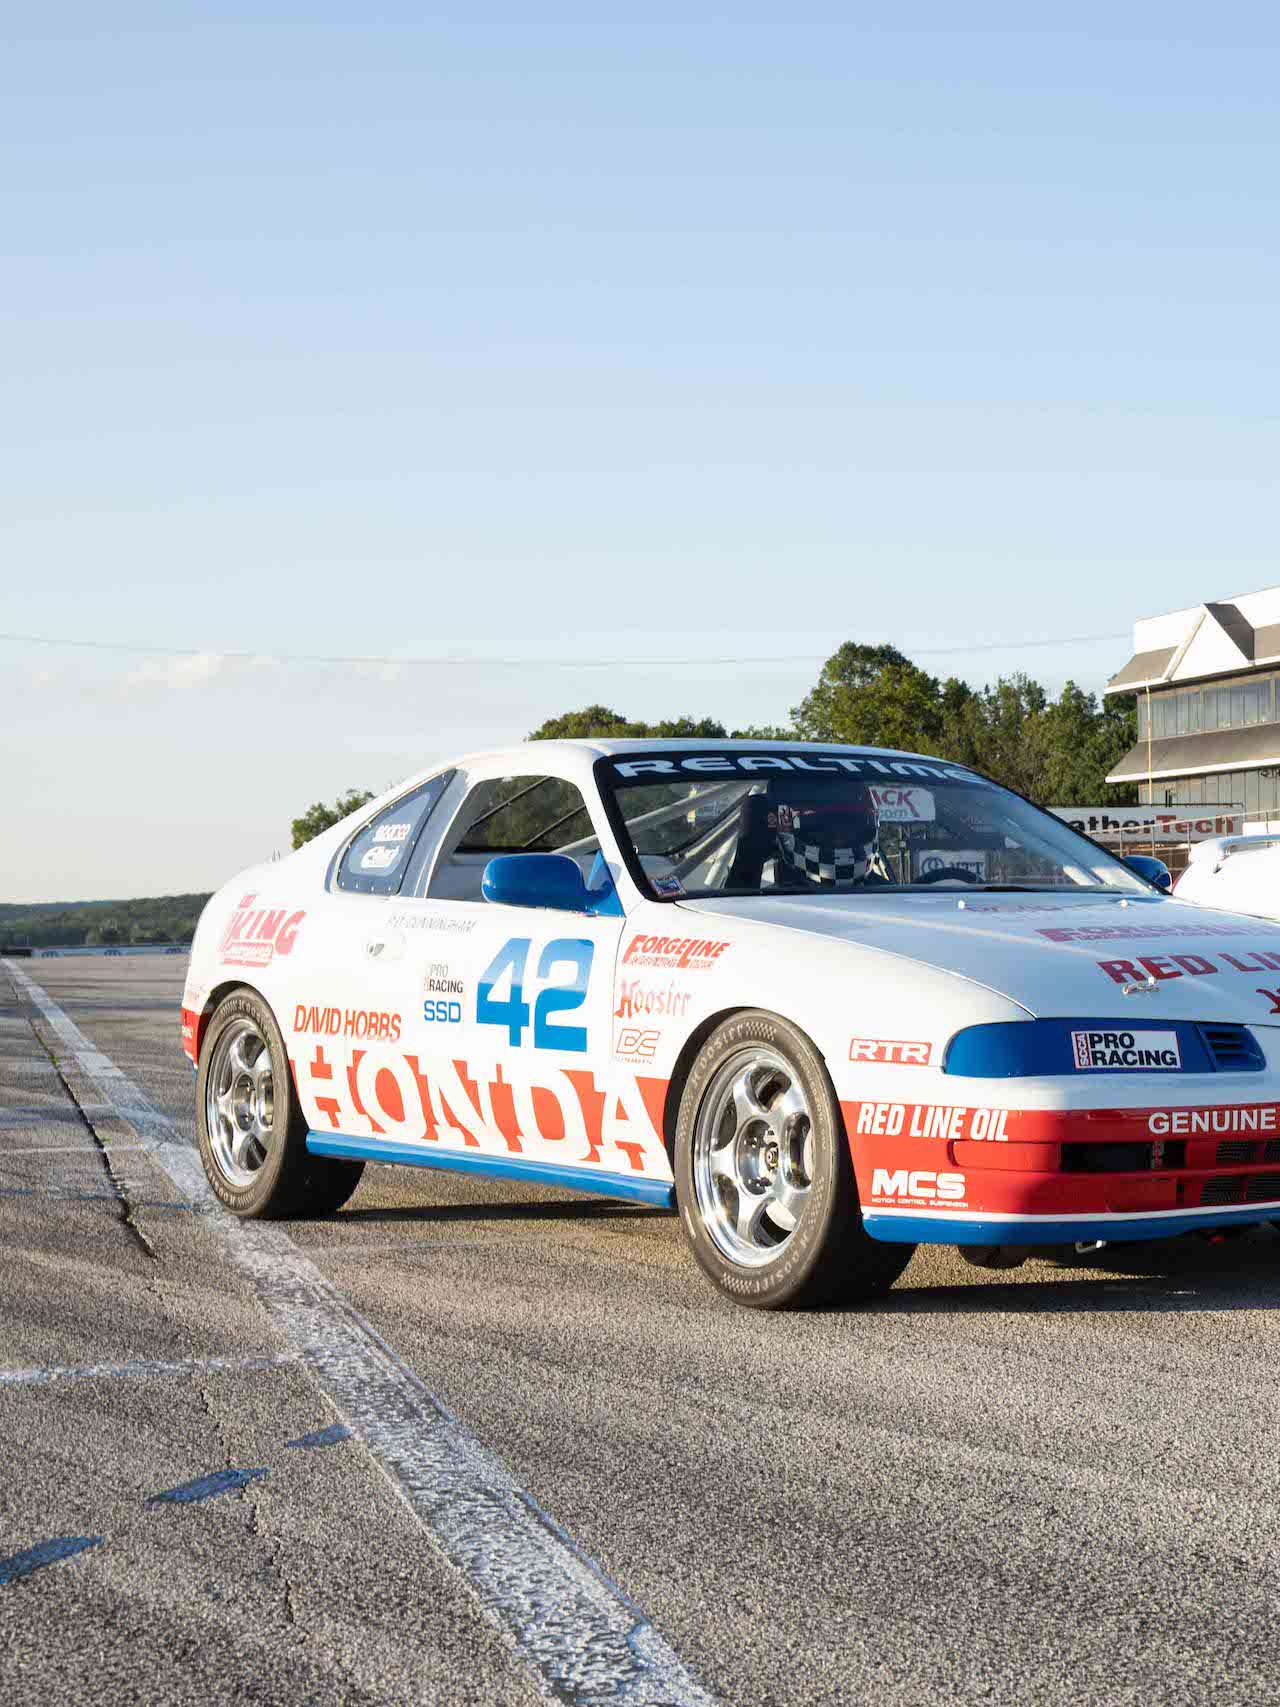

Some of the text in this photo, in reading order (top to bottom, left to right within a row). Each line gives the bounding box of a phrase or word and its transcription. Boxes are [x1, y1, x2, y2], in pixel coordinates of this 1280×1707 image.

[1069, 815, 1233, 834] atherTech
[622, 935, 730, 968] FORGELINE
[430, 963, 448, 977] PRO
[1097, 955, 1218, 983] RED
[429, 979, 464, 993] RACING
[476, 937, 595, 1052] 42
[615, 979, 691, 1018] Hoosier
[294, 1005, 341, 1035] DAVID
[344, 1010, 402, 1042] HOBBS
[424, 1000, 461, 1023] SSD
[851, 1039, 929, 1063] RTR
[1089, 1033, 1135, 1049] PRO
[1092, 1050, 1178, 1066] RACING
[294, 1043, 673, 1180] HONDA
[857, 1103, 1009, 1141] RED LINE OIL
[1148, 1109, 1277, 1135] GENUINE
[872, 1169, 965, 1199] MCS
[930, 1200, 969, 1208] SUSPENSION
